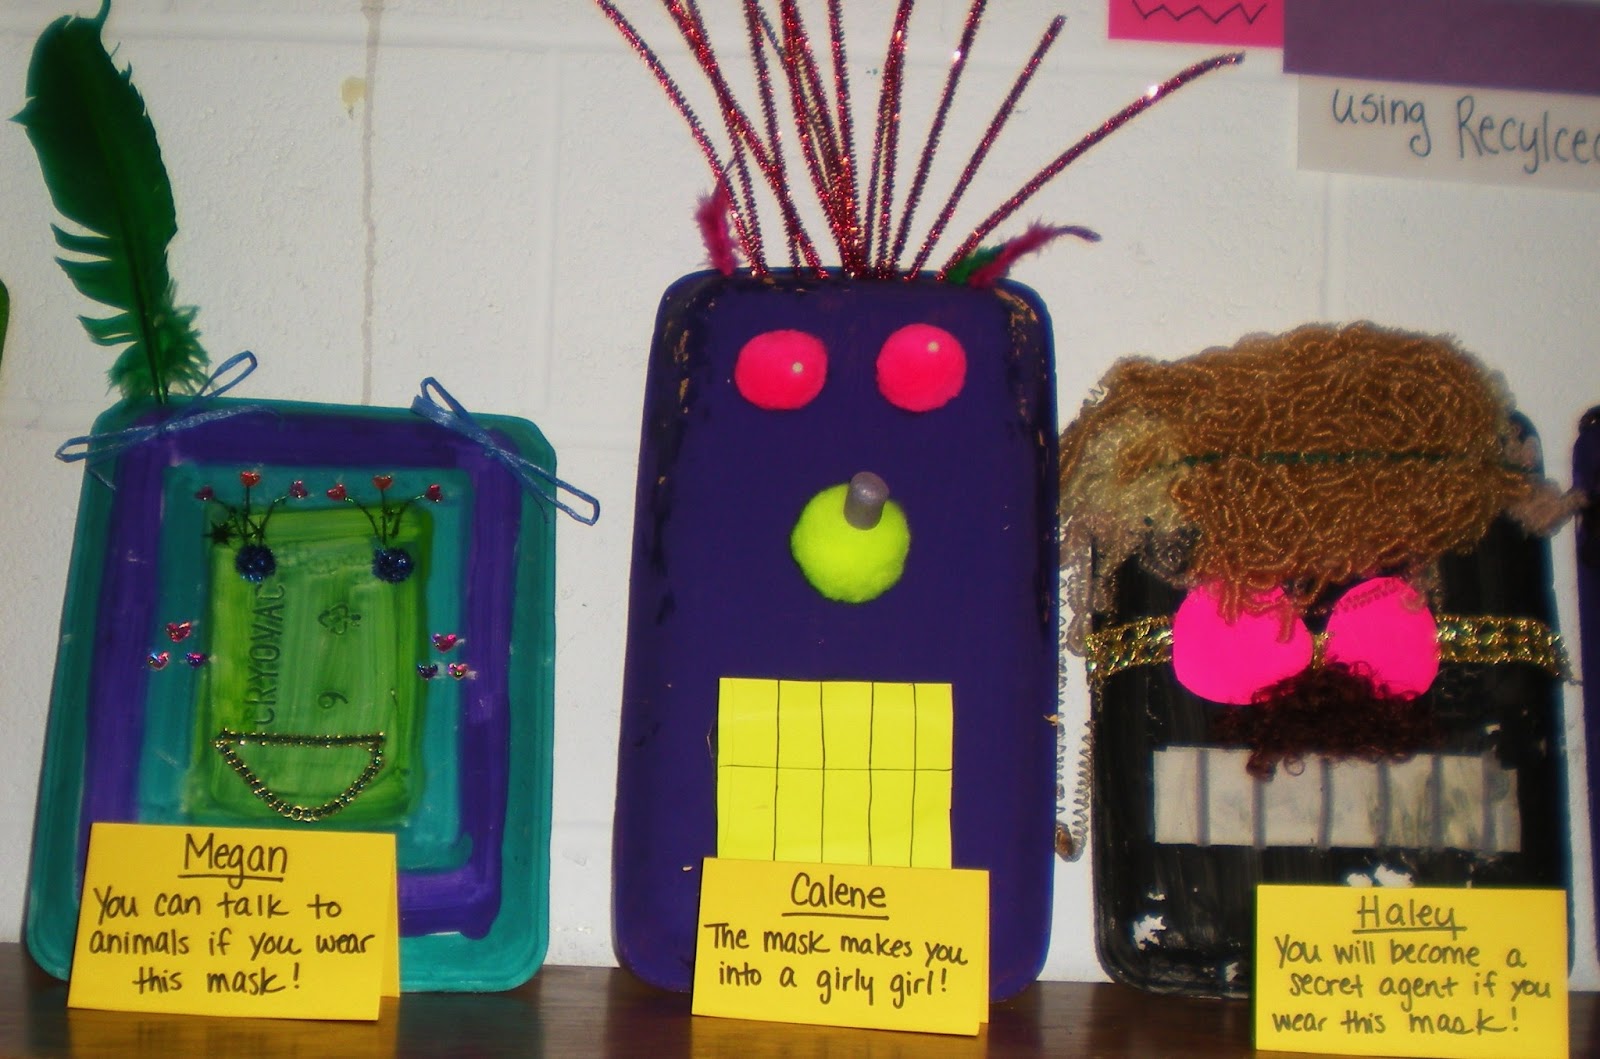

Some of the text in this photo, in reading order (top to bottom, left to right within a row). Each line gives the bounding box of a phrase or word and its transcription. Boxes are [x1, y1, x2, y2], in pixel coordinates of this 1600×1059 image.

[1457, 94, 1600, 174] Recylce
[246, 584, 285, 726] CRYOVAC
[182, 832, 288, 889] Megan
[92, 885, 342, 925] You can talk to
[790, 872, 887, 909] Calene
[1356, 895, 1458, 940] Haley
[89, 926, 375, 961] animals if you wear
[704, 922, 968, 968] The mask makes you
[1274, 933, 1528, 969] You will become a
[132, 962, 300, 996] this mask!
[718, 961, 948, 1010] into a girly girl!
[1289, 970, 1552, 1013] secret agent if you
[1272, 1012, 1328, 1033] wear
[1340, 1009, 1386, 1035] this
